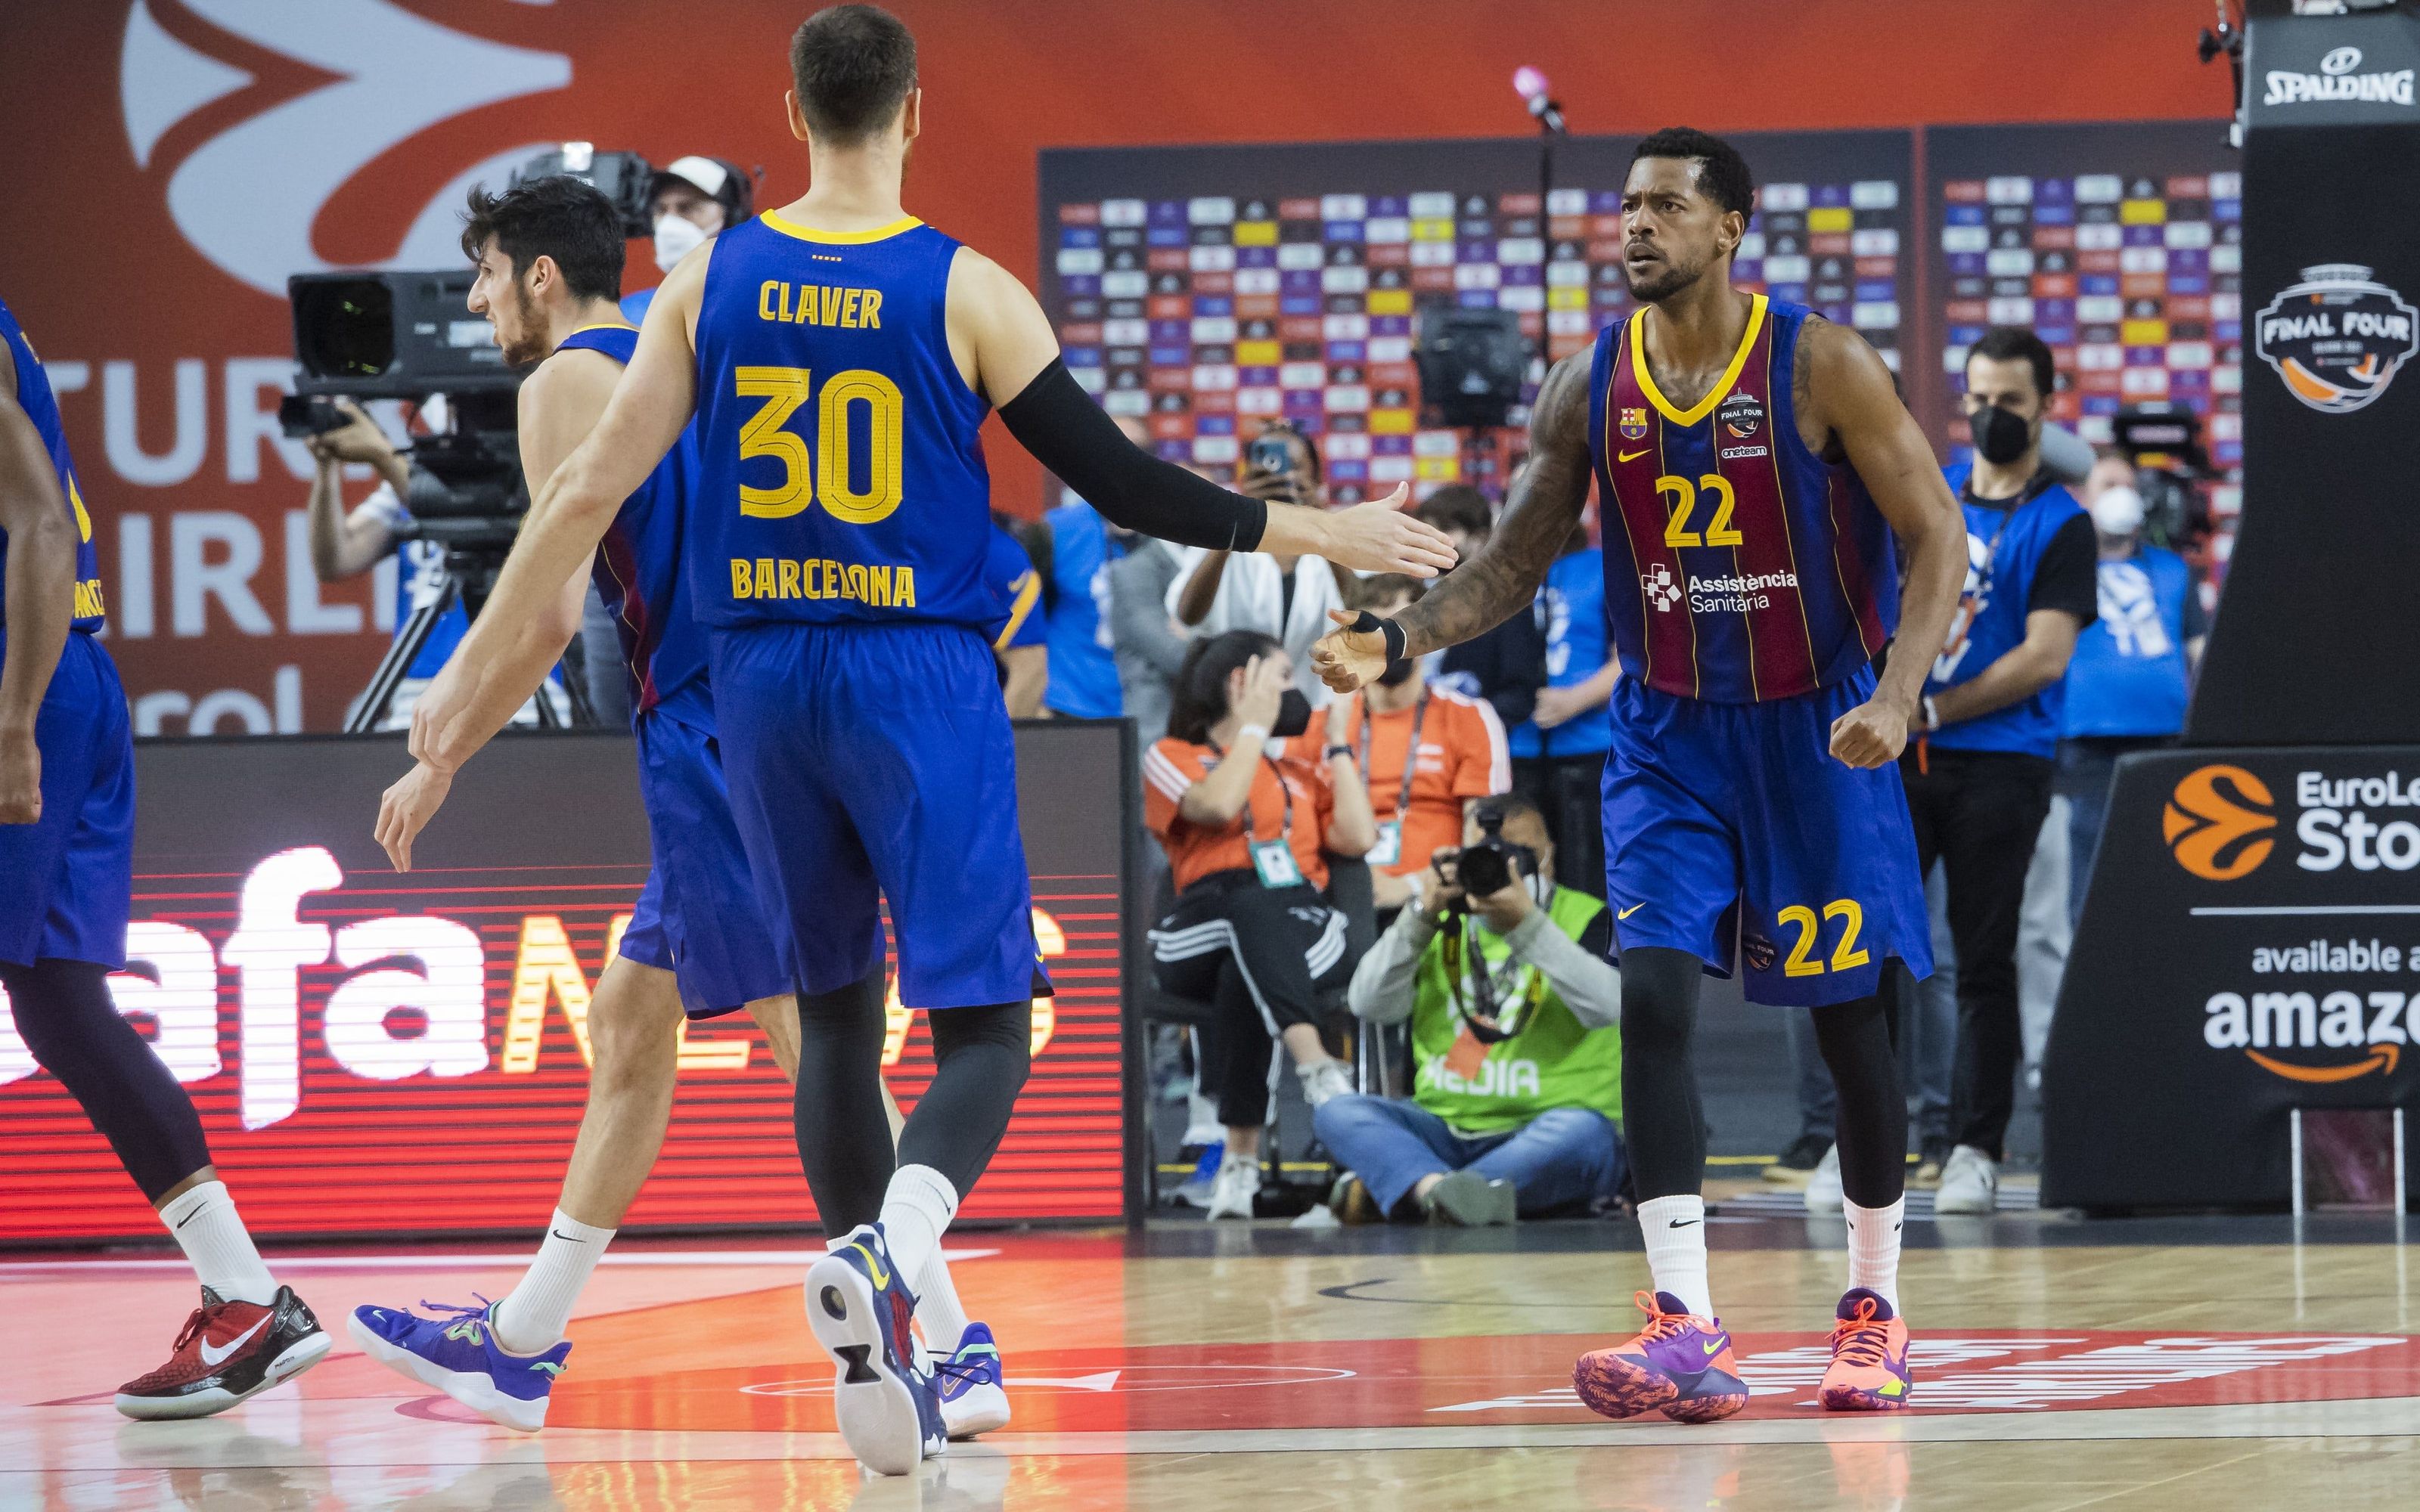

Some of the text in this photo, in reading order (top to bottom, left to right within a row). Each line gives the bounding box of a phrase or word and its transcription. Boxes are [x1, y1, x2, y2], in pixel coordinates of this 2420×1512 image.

[2263, 70, 2415, 106] SPALDING
[759, 280, 883, 329] CLAVER
[2263, 311, 2410, 345] FINAL FOUR
[1721, 410, 1741, 420] FINAL
[735, 366, 903, 524] 30
[1655, 474, 1743, 547] 22
[731, 559, 916, 608] BARCELONA
[1689, 569, 1798, 593] Assistència
[1690, 592, 1770, 613] Sanitària
[1778, 898, 1870, 978] 22
[2251, 938, 2402, 973] available
[2204, 991, 2420, 1049] amaz
